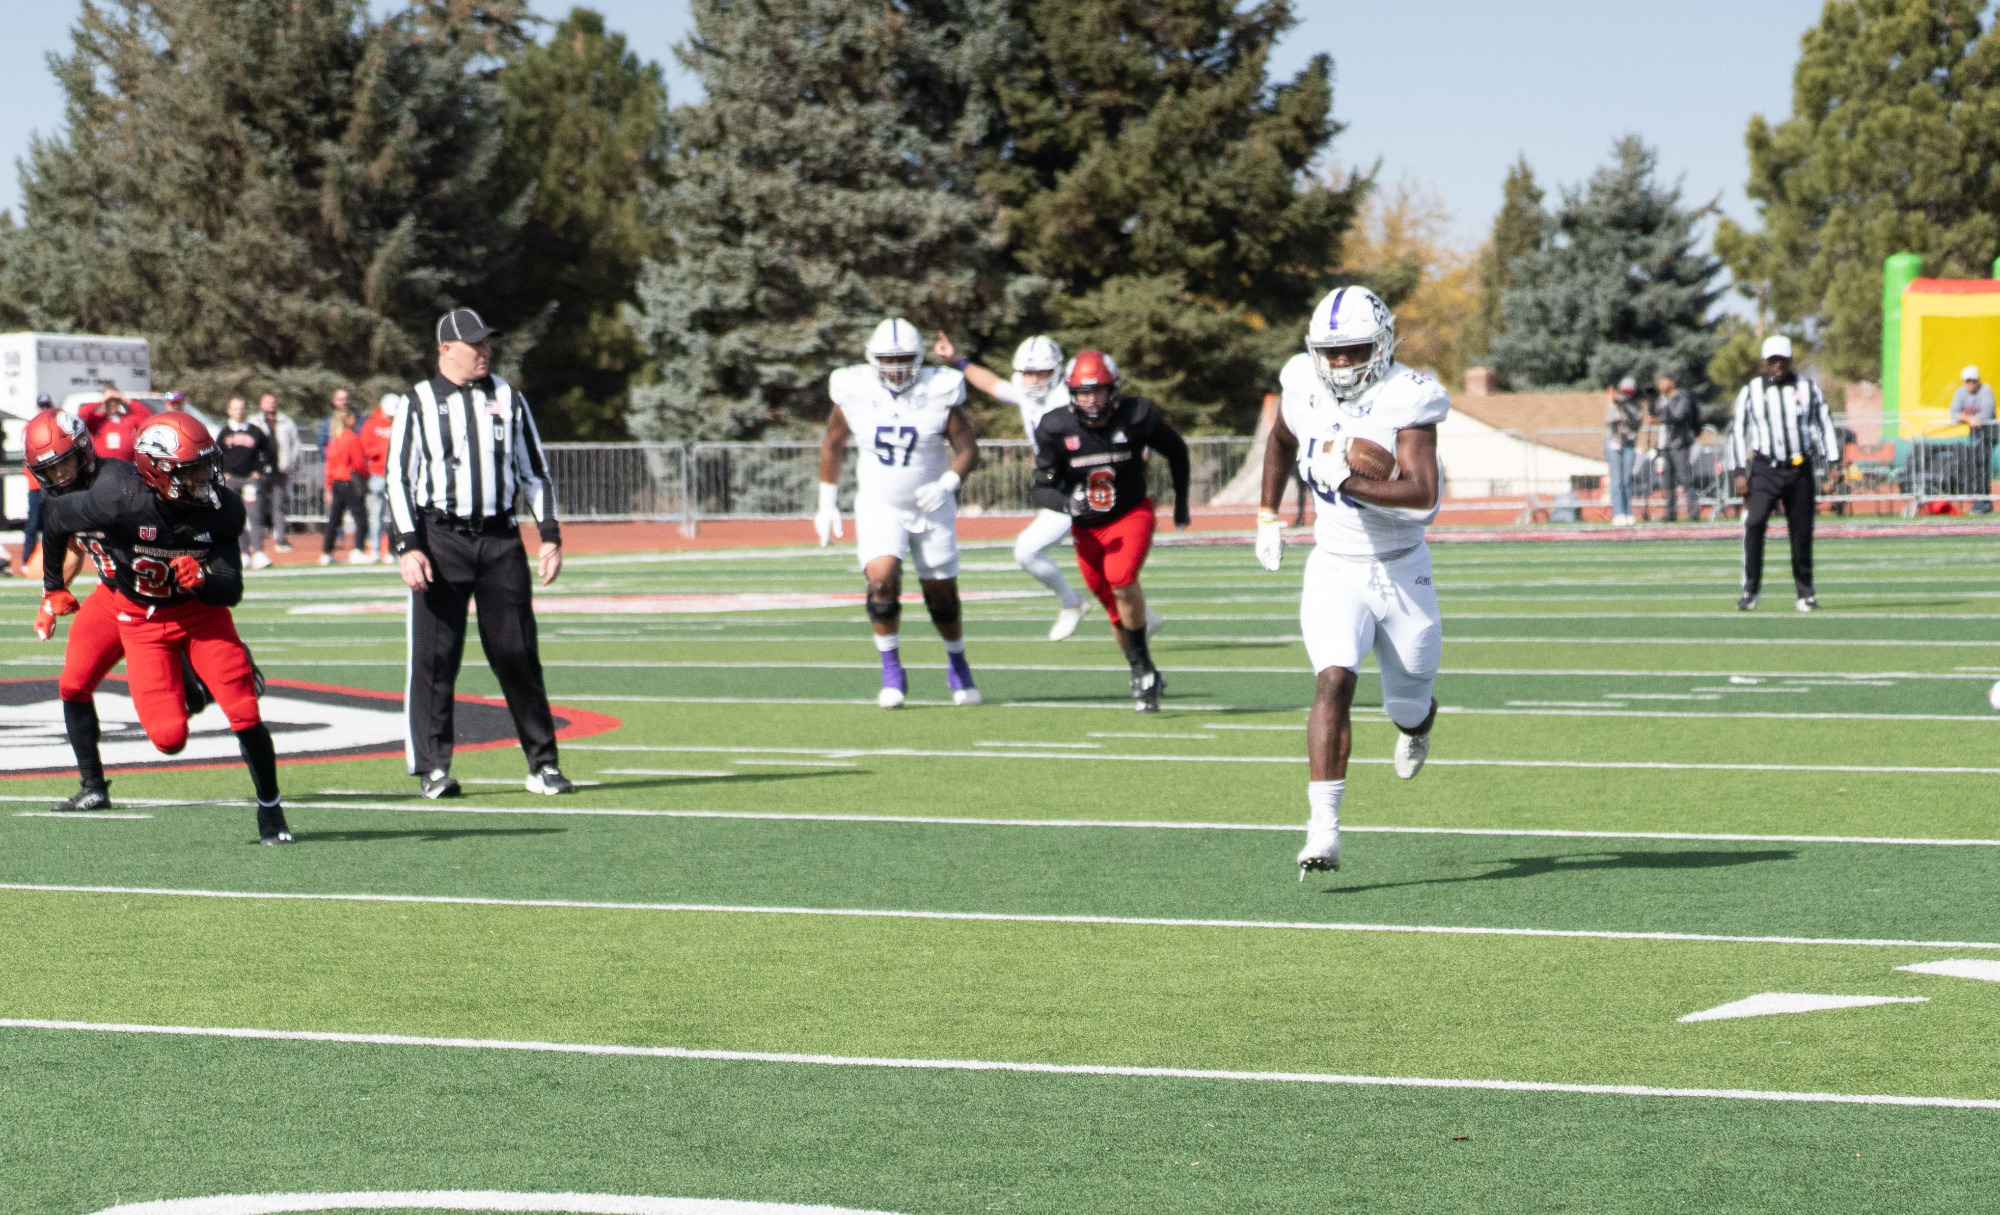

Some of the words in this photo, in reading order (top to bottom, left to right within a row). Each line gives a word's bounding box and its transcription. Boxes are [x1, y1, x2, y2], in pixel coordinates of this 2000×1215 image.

[494, 426, 504, 441] U
[875, 426, 919, 467] 57
[1086, 465, 1116, 512] 6
